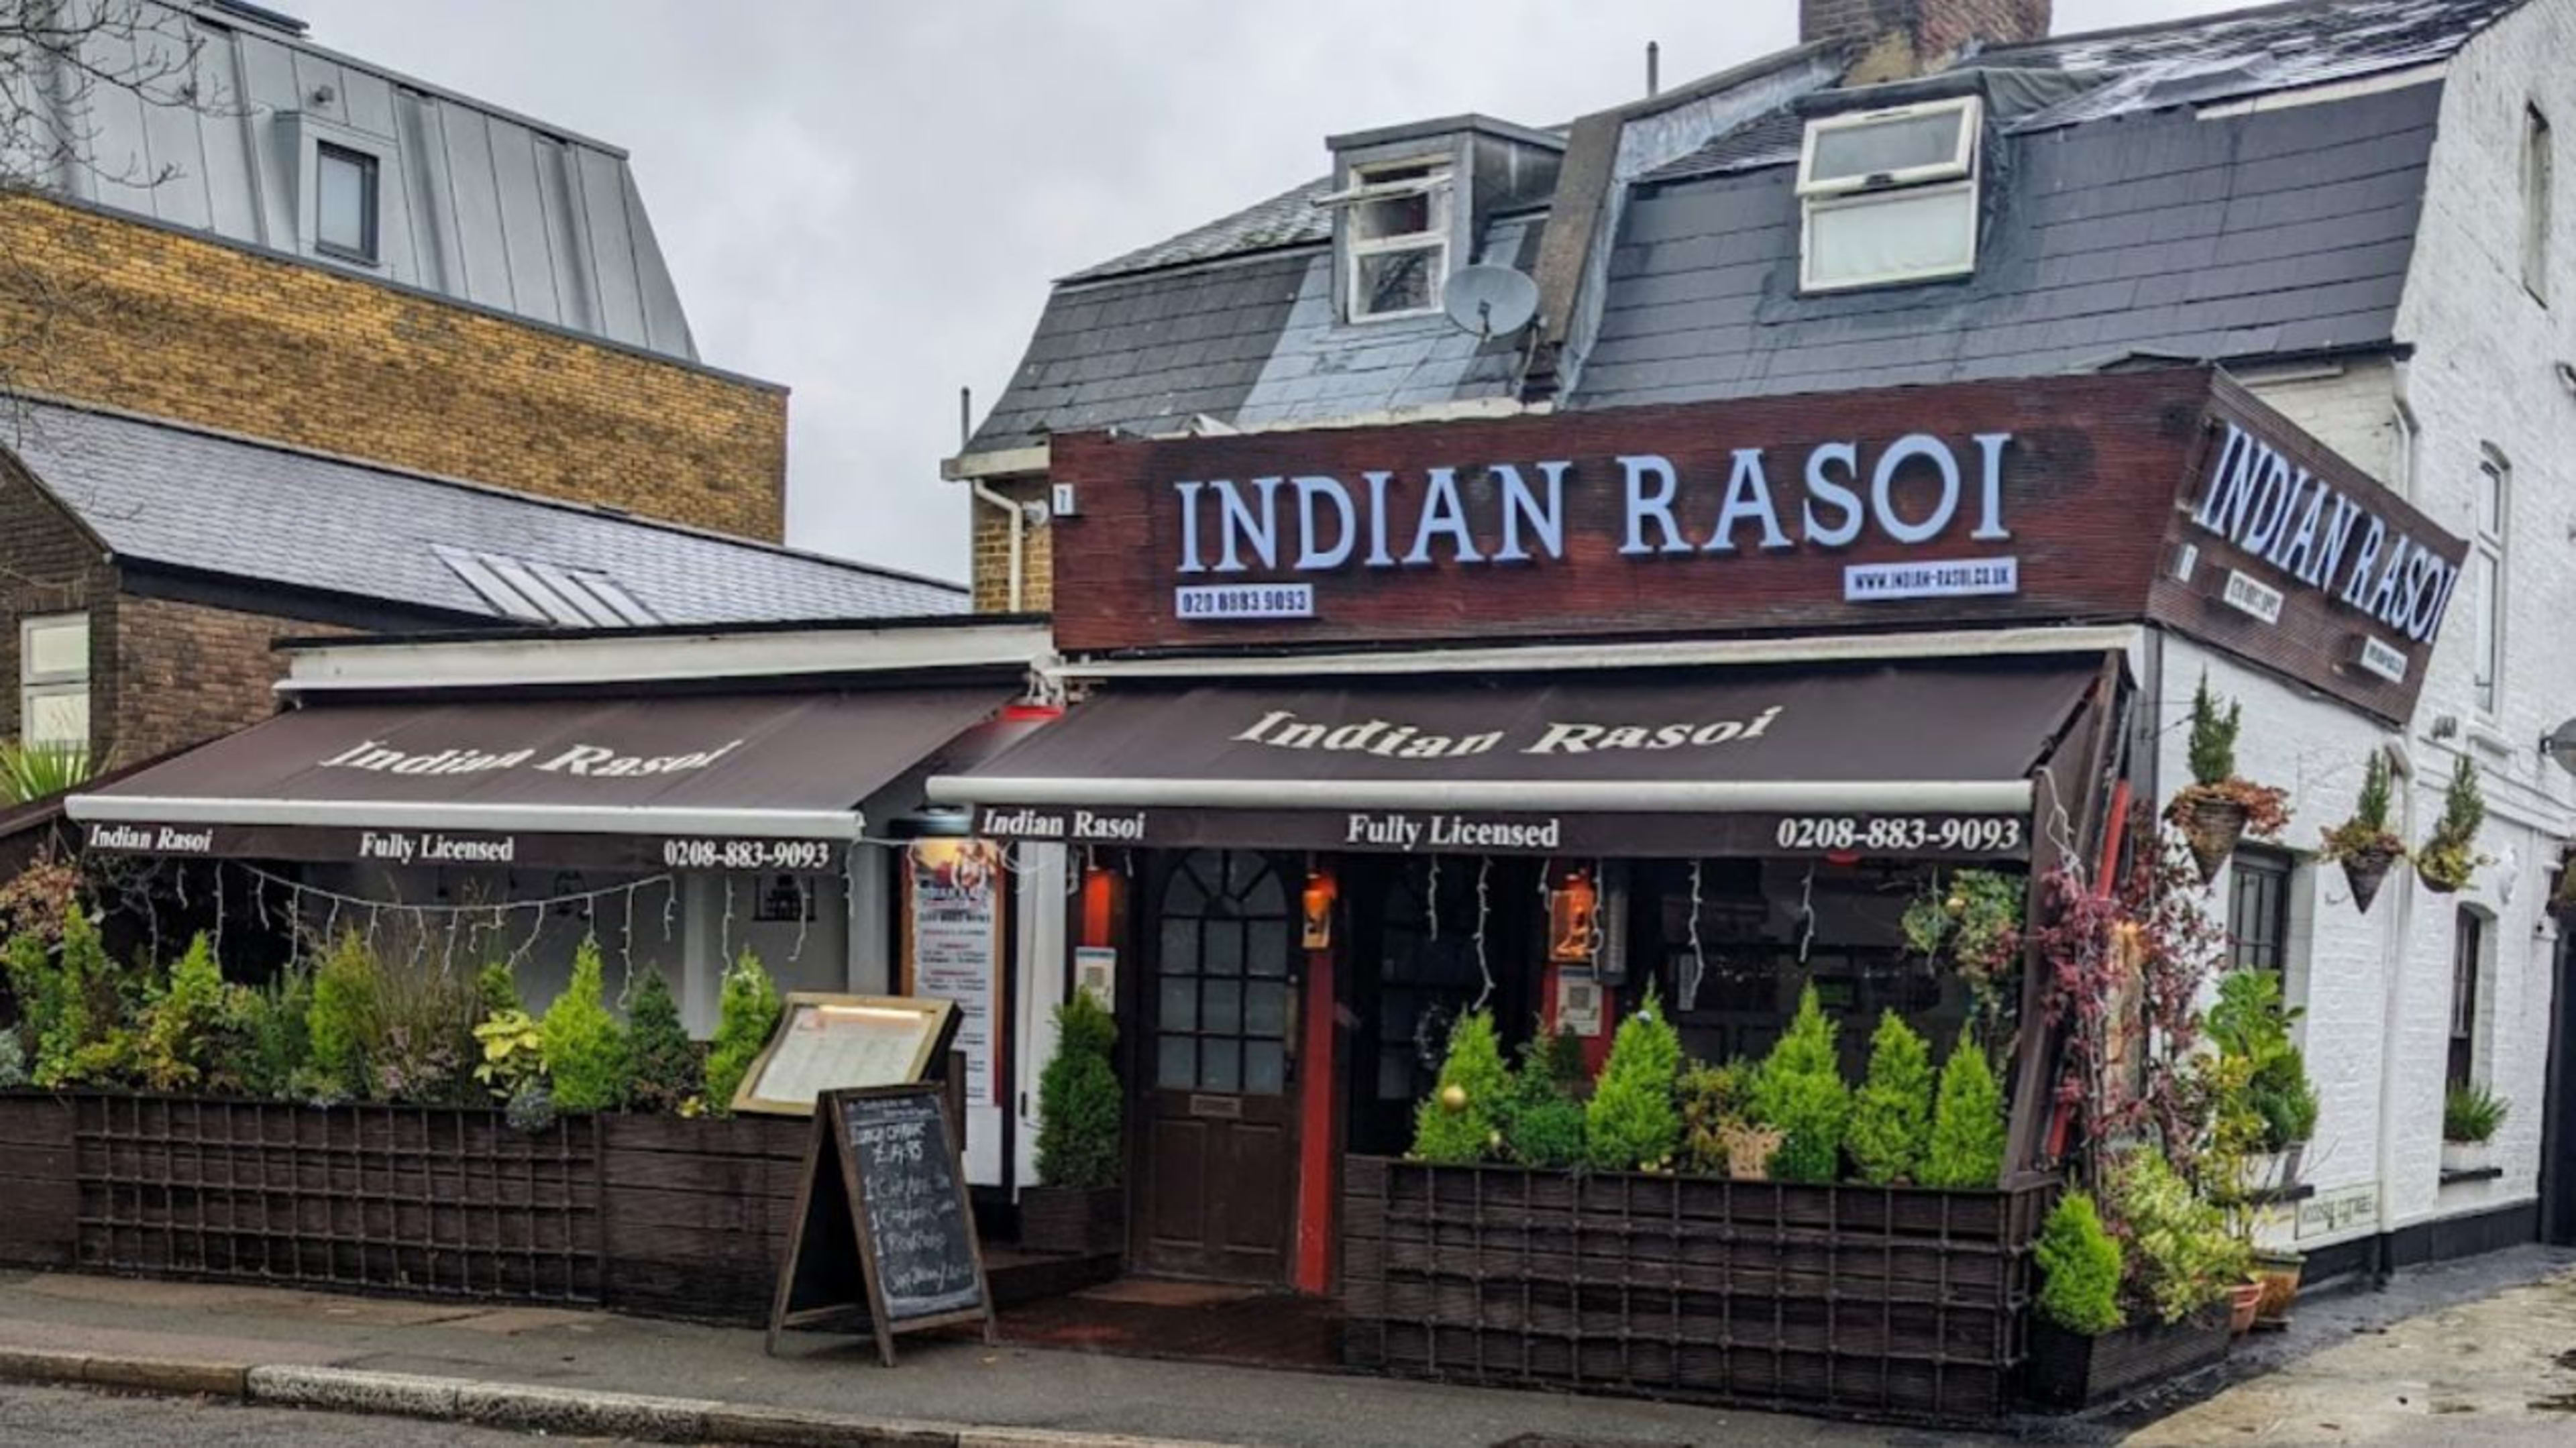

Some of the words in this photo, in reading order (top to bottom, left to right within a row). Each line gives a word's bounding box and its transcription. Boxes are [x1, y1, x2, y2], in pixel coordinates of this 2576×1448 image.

[1175, 461, 1571, 573] INDIAN
[1616, 433, 2011, 555] RASOI
[2192, 422, 2363, 594] INDIAN
[2343, 516, 2457, 644] RASOI
[1183, 593, 1213, 612] 020
[1265, 590, 1306, 611] 9093
[1230, 711, 1504, 759] Indian
[1520, 706, 1783, 755] Rasoi
[319, 740, 535, 775] Indian
[534, 739, 743, 777] Rasoi
[89, 824, 151, 849] Indian
[156, 828, 213, 853] Rasoi
[981, 809, 1064, 836] Indian
[1072, 812, 1145, 840] Rasoi
[1346, 814, 1422, 851] Fully
[1429, 816, 1560, 848] Licensed
[1776, 817, 2020, 850] 0208-883-9093
[359, 832, 415, 864] Fully
[420, 834, 514, 862] Licensed
[663, 840, 829, 869] 0208-883-9093
